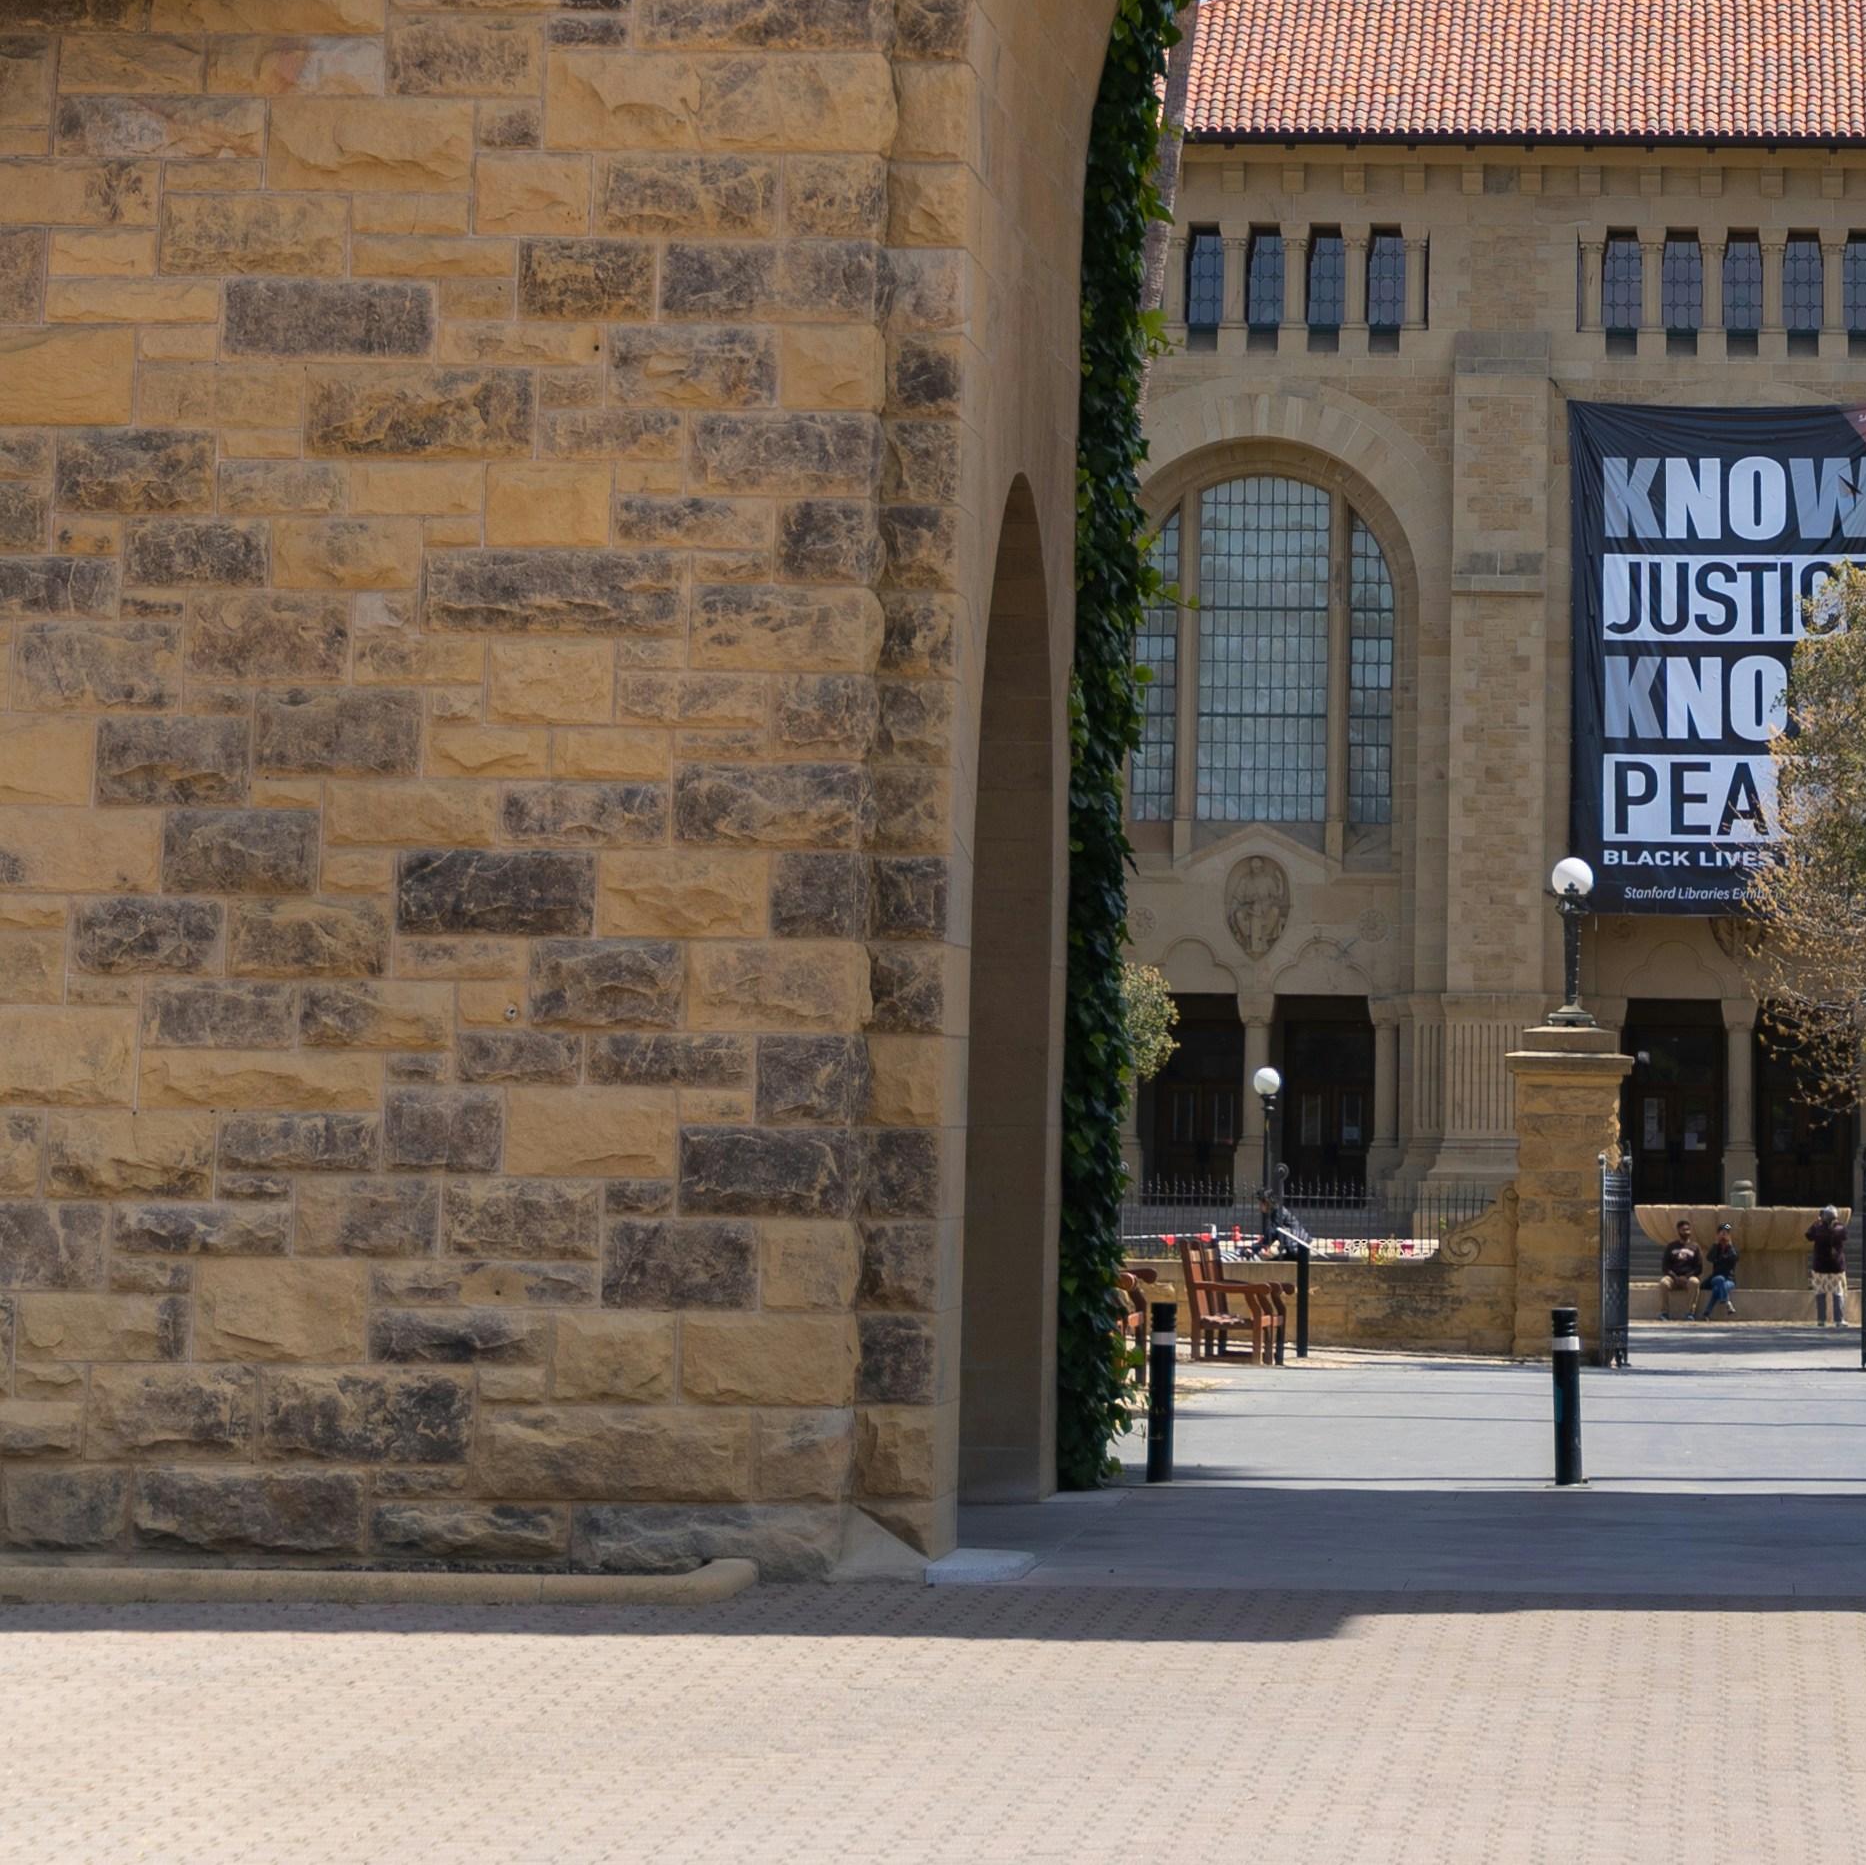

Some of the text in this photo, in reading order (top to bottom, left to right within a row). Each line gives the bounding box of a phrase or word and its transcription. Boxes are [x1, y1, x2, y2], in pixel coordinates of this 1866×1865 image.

[1604, 655, 1793, 741] KNO
[1603, 850, 1691, 866] BLACK
[1699, 851, 1775, 867] LIVES
[1624, 886, 1676, 899] Stanford
[1678, 886, 1730, 900] Libraries
